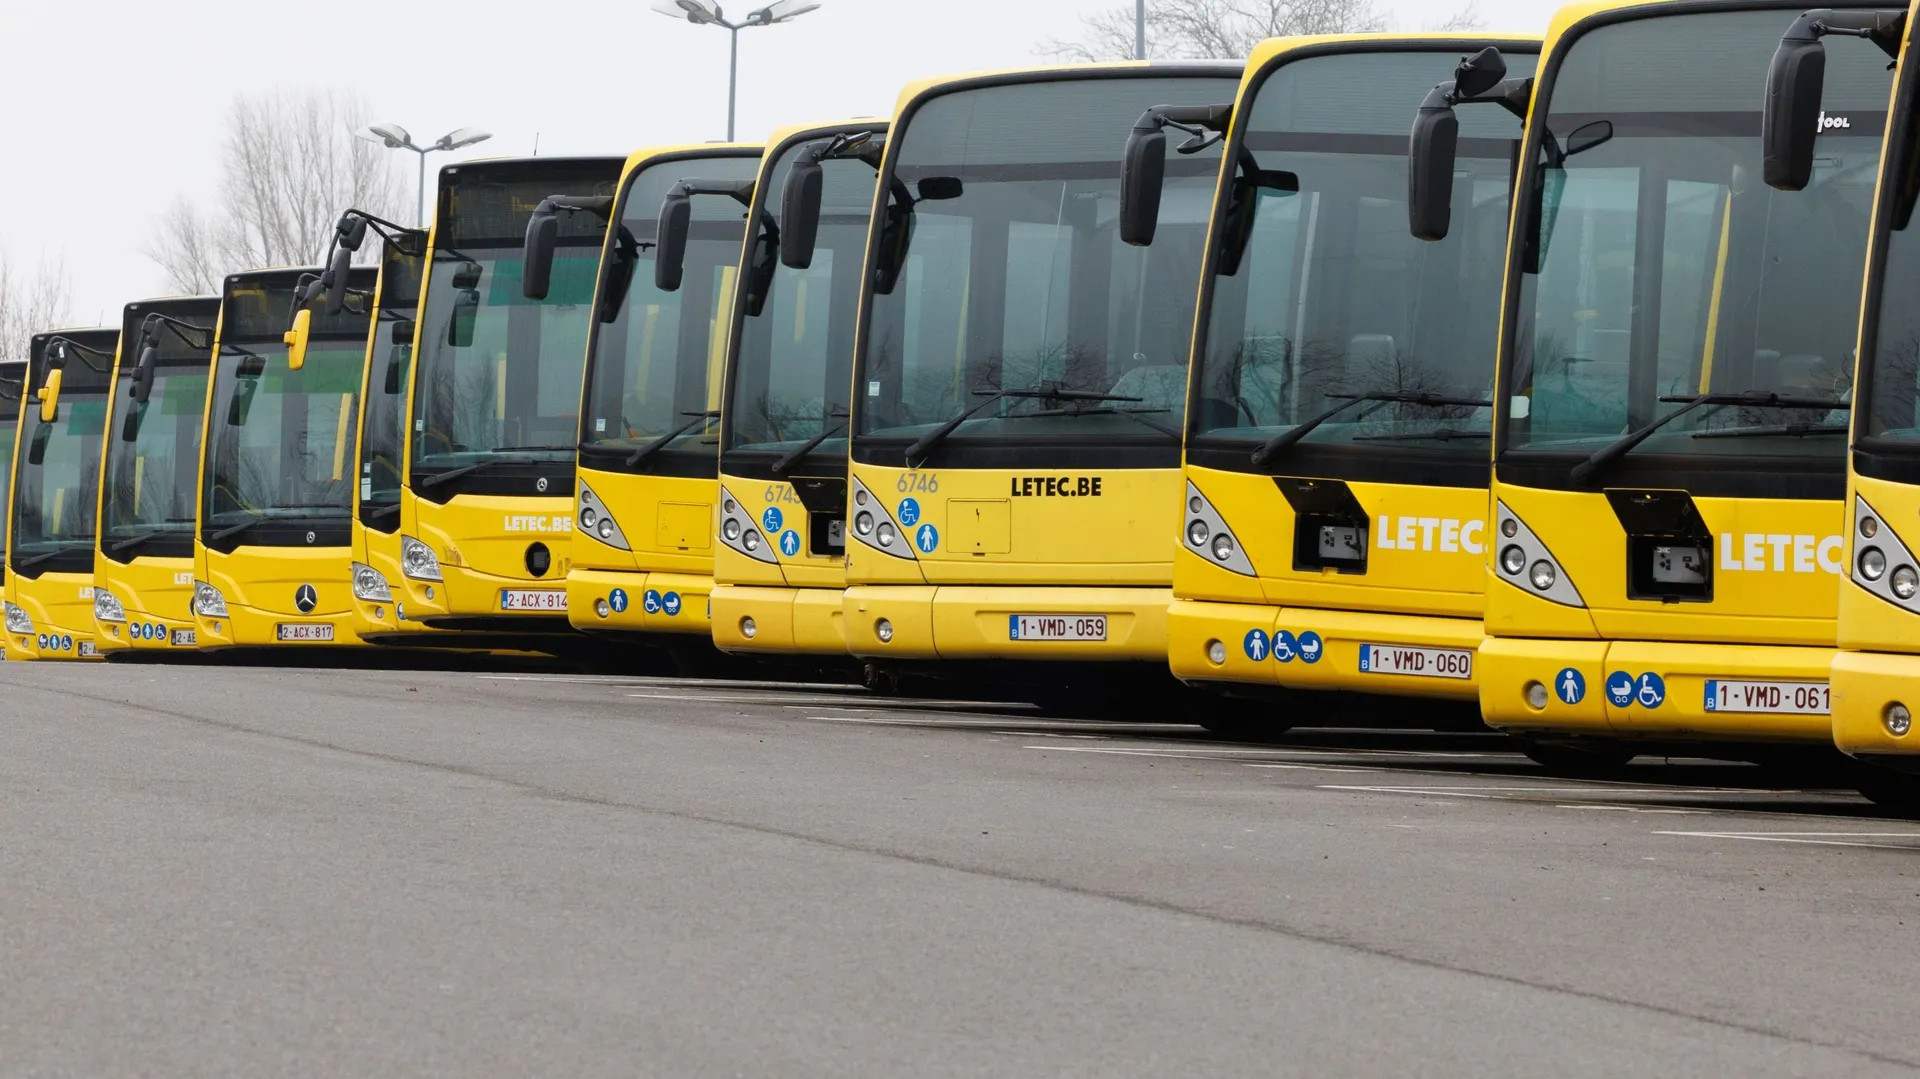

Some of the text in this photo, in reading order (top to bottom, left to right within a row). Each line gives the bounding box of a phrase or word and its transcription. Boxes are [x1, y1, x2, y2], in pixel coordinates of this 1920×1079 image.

[897, 473, 938, 494] 6746
[1011, 477, 1102, 497] LETEC.BE
[504, 516, 572, 532] LETEC.BE
[1377, 515, 1488, 555] LETEC
[1720, 533, 1843, 574] LETEC
[1020, 618, 1104, 636] 1-VMD-059
[1373, 649, 1469, 673] 1-VMD-060
[1720, 685, 1830, 709] 1-VMD-061
